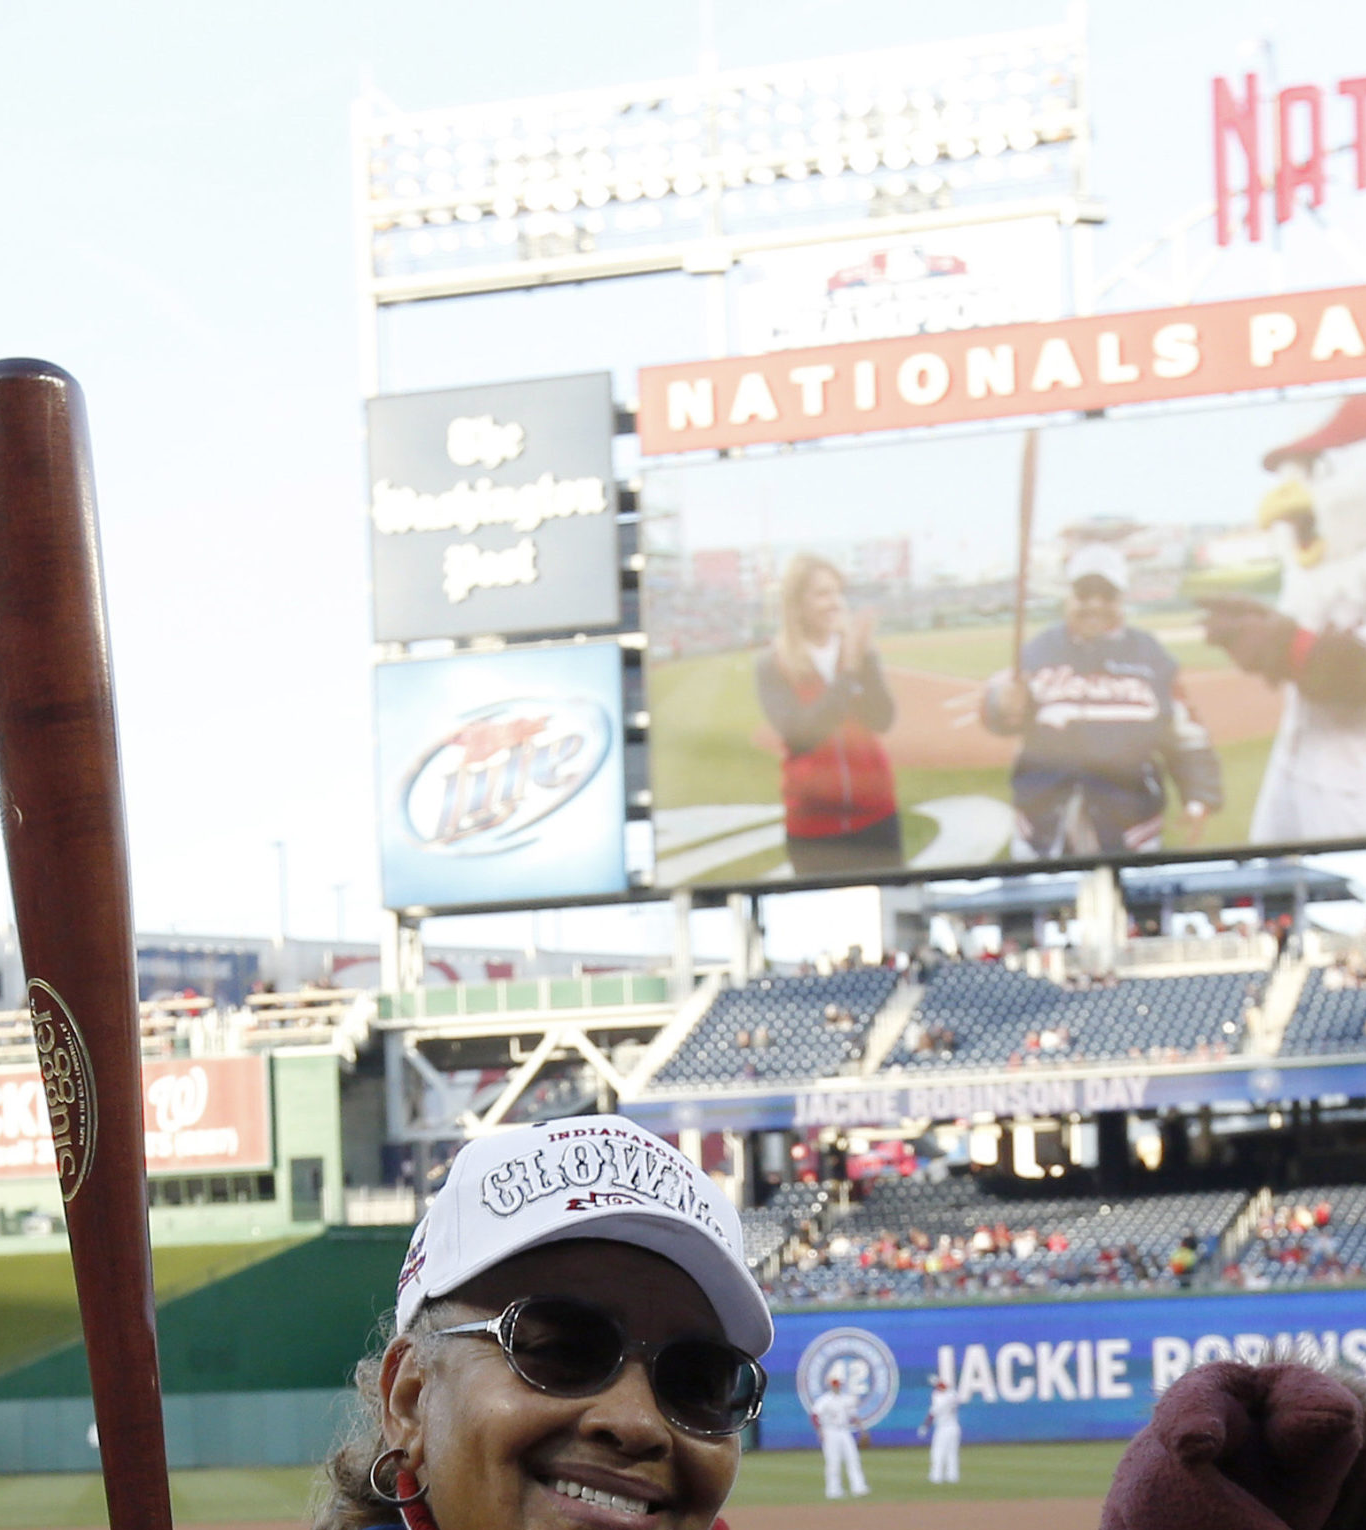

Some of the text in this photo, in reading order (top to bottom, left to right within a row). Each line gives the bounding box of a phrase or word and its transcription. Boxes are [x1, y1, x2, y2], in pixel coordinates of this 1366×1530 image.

[668, 324, 1200, 432] NATIONALS
[32, 1010, 76, 1179] Slugger
[793, 1075, 1150, 1127] JACKIE ROBINSON DAY
[482, 1139, 731, 1248] CLOWNS
[548, 1128, 695, 1181] INDIANAPOLIS
[936, 1338, 1132, 1402] JACKIE
